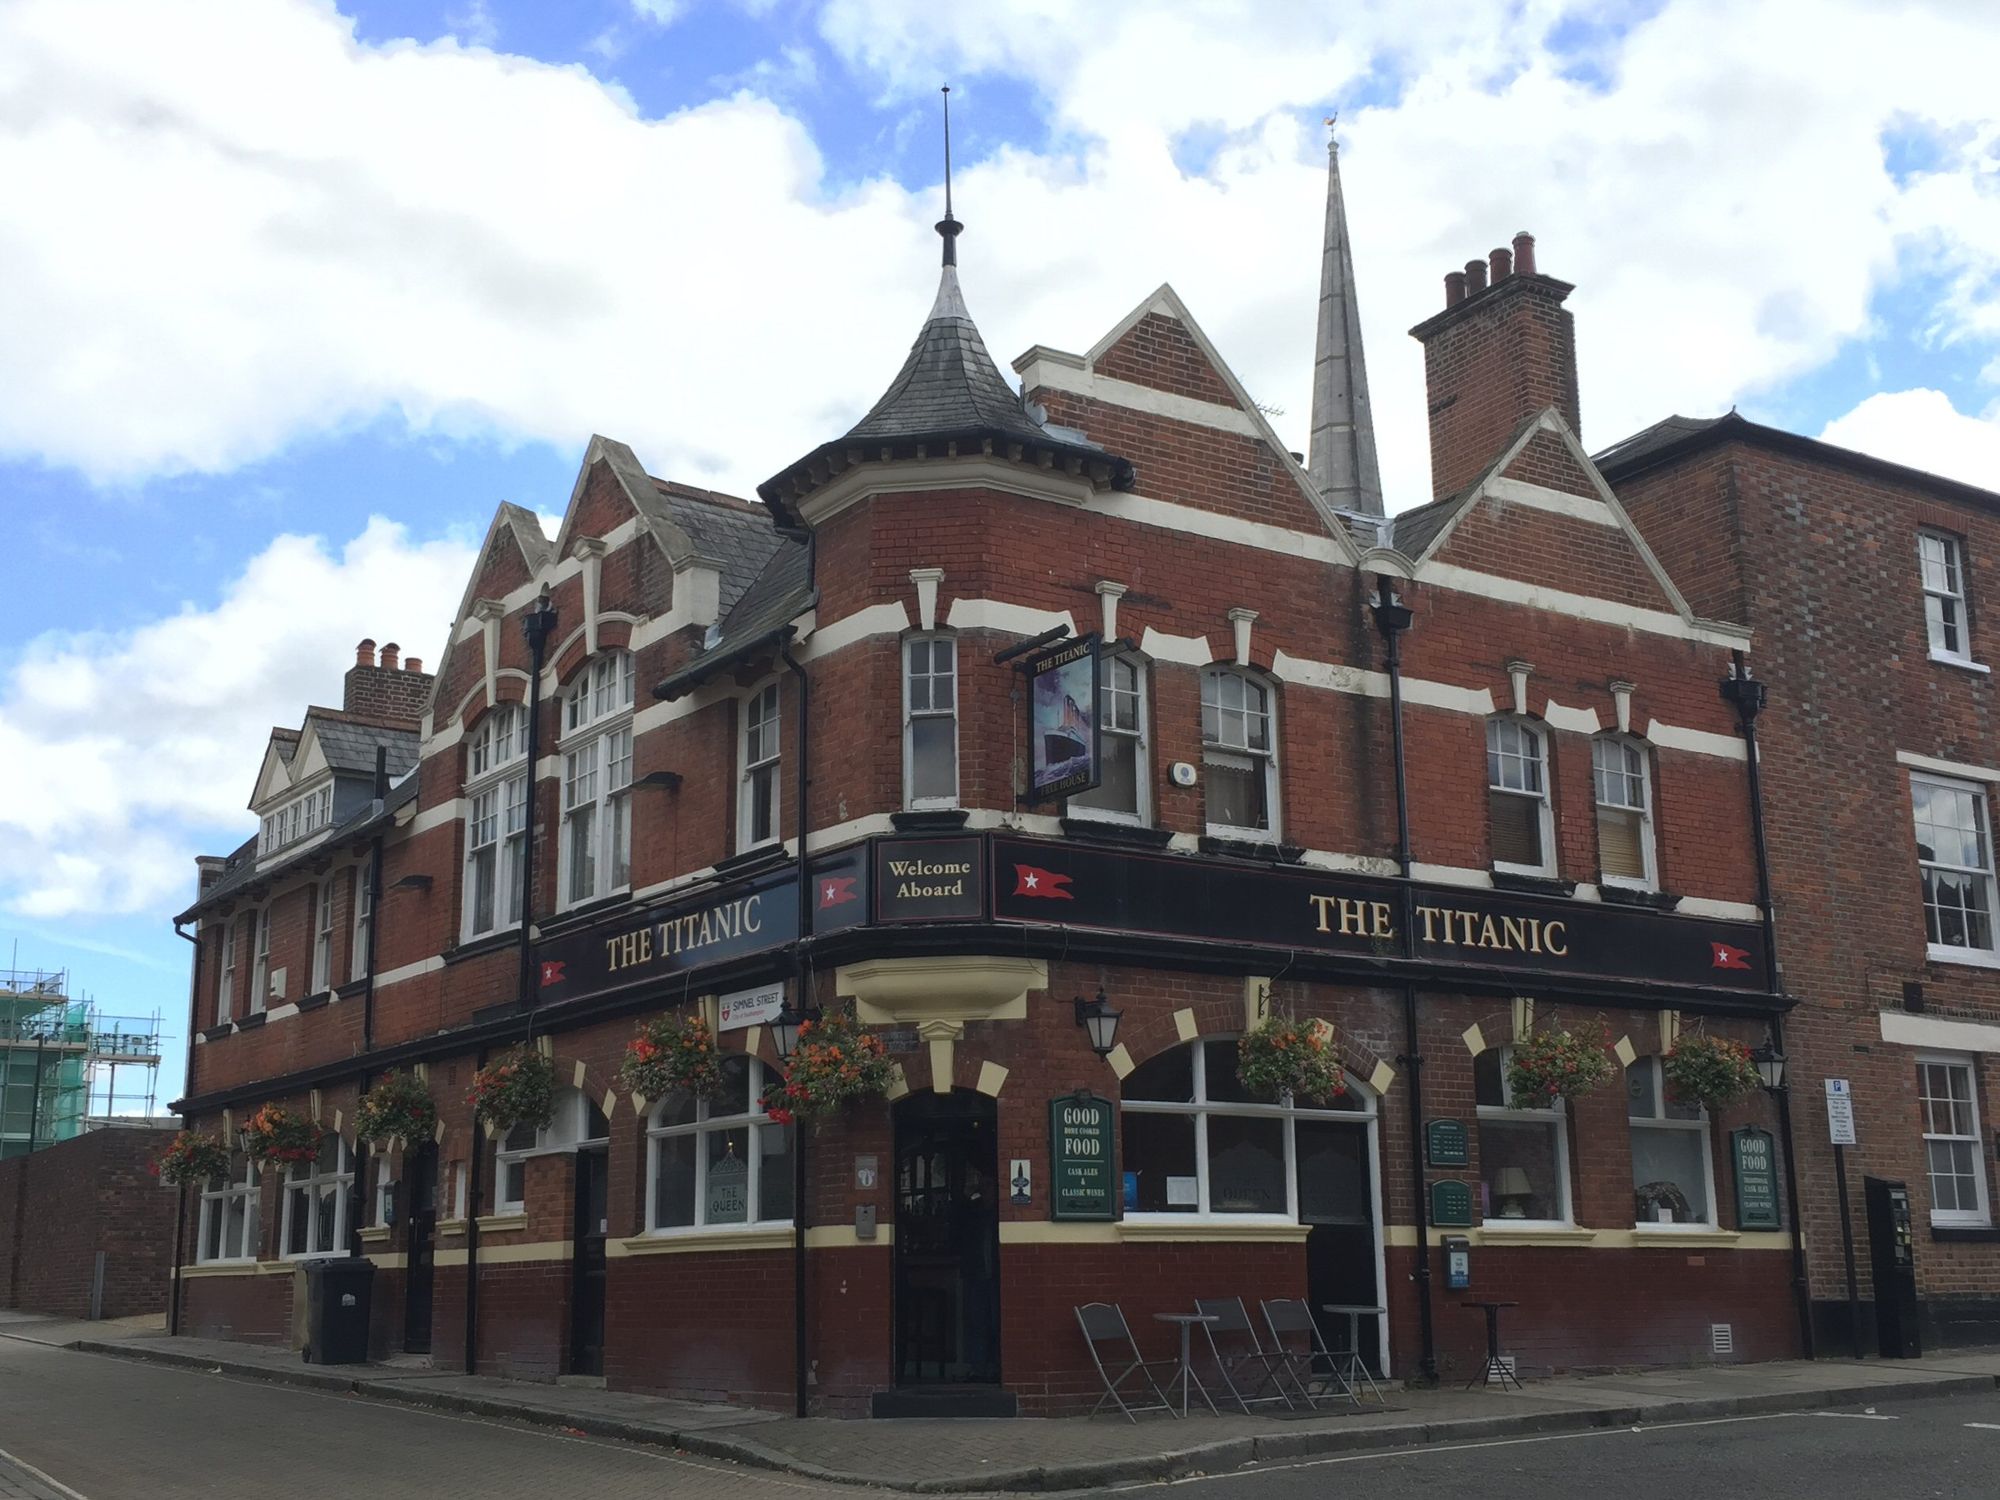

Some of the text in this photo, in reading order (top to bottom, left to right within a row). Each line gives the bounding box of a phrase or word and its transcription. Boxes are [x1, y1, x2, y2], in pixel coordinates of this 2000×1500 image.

[1035, 642, 1090, 673] THE TITANIC
[1041, 773, 1086, 796] FREE HOUSE
[888, 859, 971, 877] Welcome
[896, 879, 963, 898] Aboard
[606, 894, 761, 972] THE TITANIC
[1309, 894, 1568, 956] THE TITANIC
[733, 992, 779, 1011] SIMNEL STREET
[1064, 1107, 1100, 1126] GOOD
[1079, 1127, 1100, 1135] COOKED
[1065, 1138, 1100, 1156] FOOD
[1740, 1138, 1766, 1154] GOOD
[1742, 1155, 1767, 1170] FOOD
[1067, 1168, 1098, 1176] CASK ALES
[721, 1187, 737, 1198] THE
[1062, 1188, 1105, 1197] CLASSIC WINES
[712, 1199, 745, 1213] QUEEN
